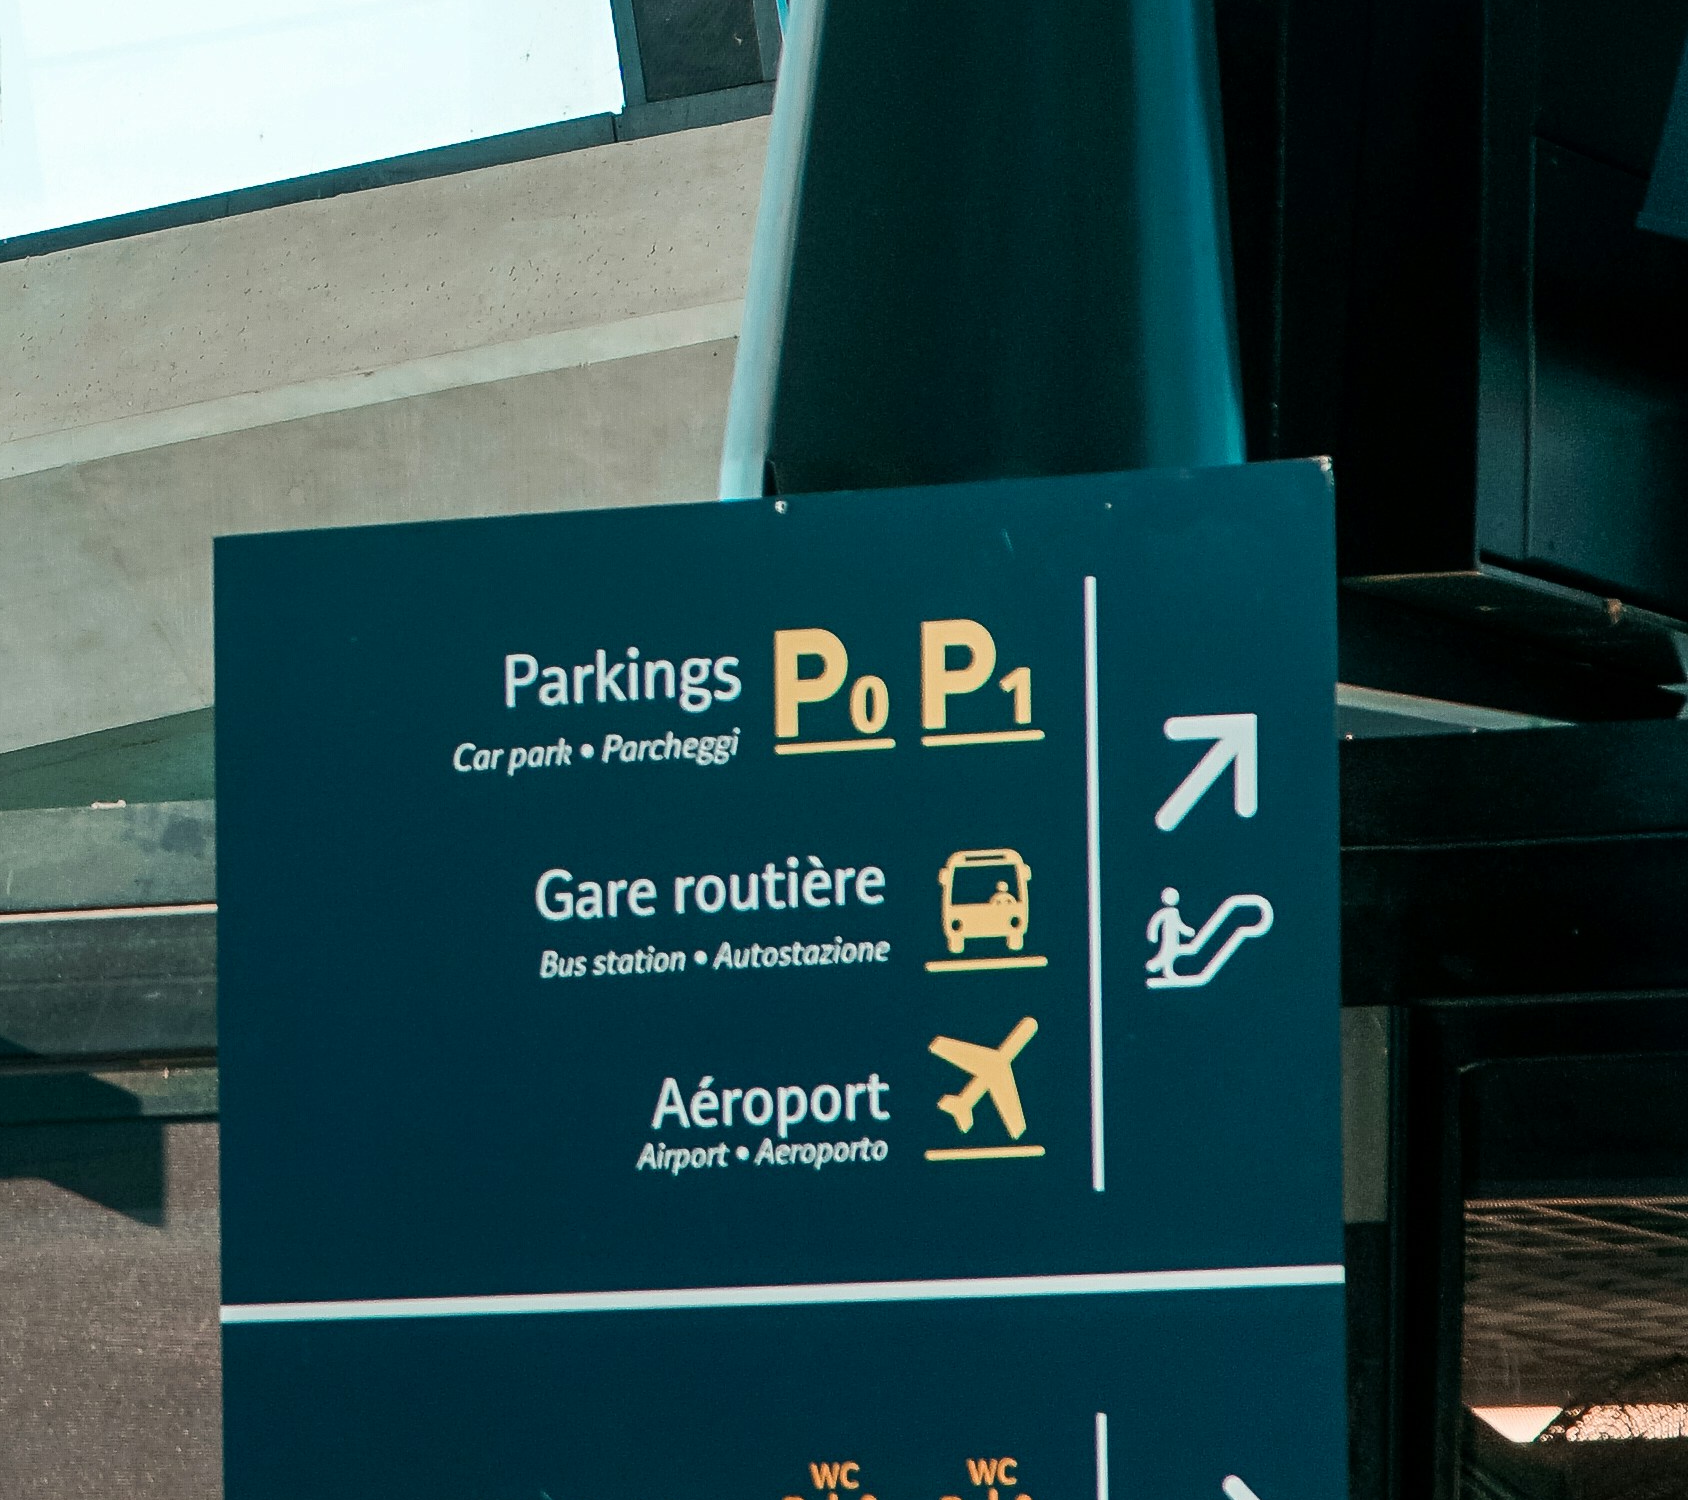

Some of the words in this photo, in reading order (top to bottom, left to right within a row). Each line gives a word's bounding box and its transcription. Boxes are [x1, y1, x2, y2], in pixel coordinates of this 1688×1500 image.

[505, 646, 742, 713] Parkings
[920, 618, 1033, 729] P1
[452, 742, 505, 772] Car
[507, 737, 573, 777] park
[601, 726, 741, 766] Parcheggi
[535, 868, 657, 921] Gare
[674, 855, 886, 914] routière
[539, 949, 587, 979] Bus
[592, 945, 687, 976] station
[712, 935, 891, 970] Autostazione
[651, 1073, 891, 1139] Aéroport
[635, 1142, 730, 1177] Airport
[753, 1137, 889, 1170] Aeroporto
[809, 1460, 860, 1490] WC
[966, 1457, 1018, 1486] WC
